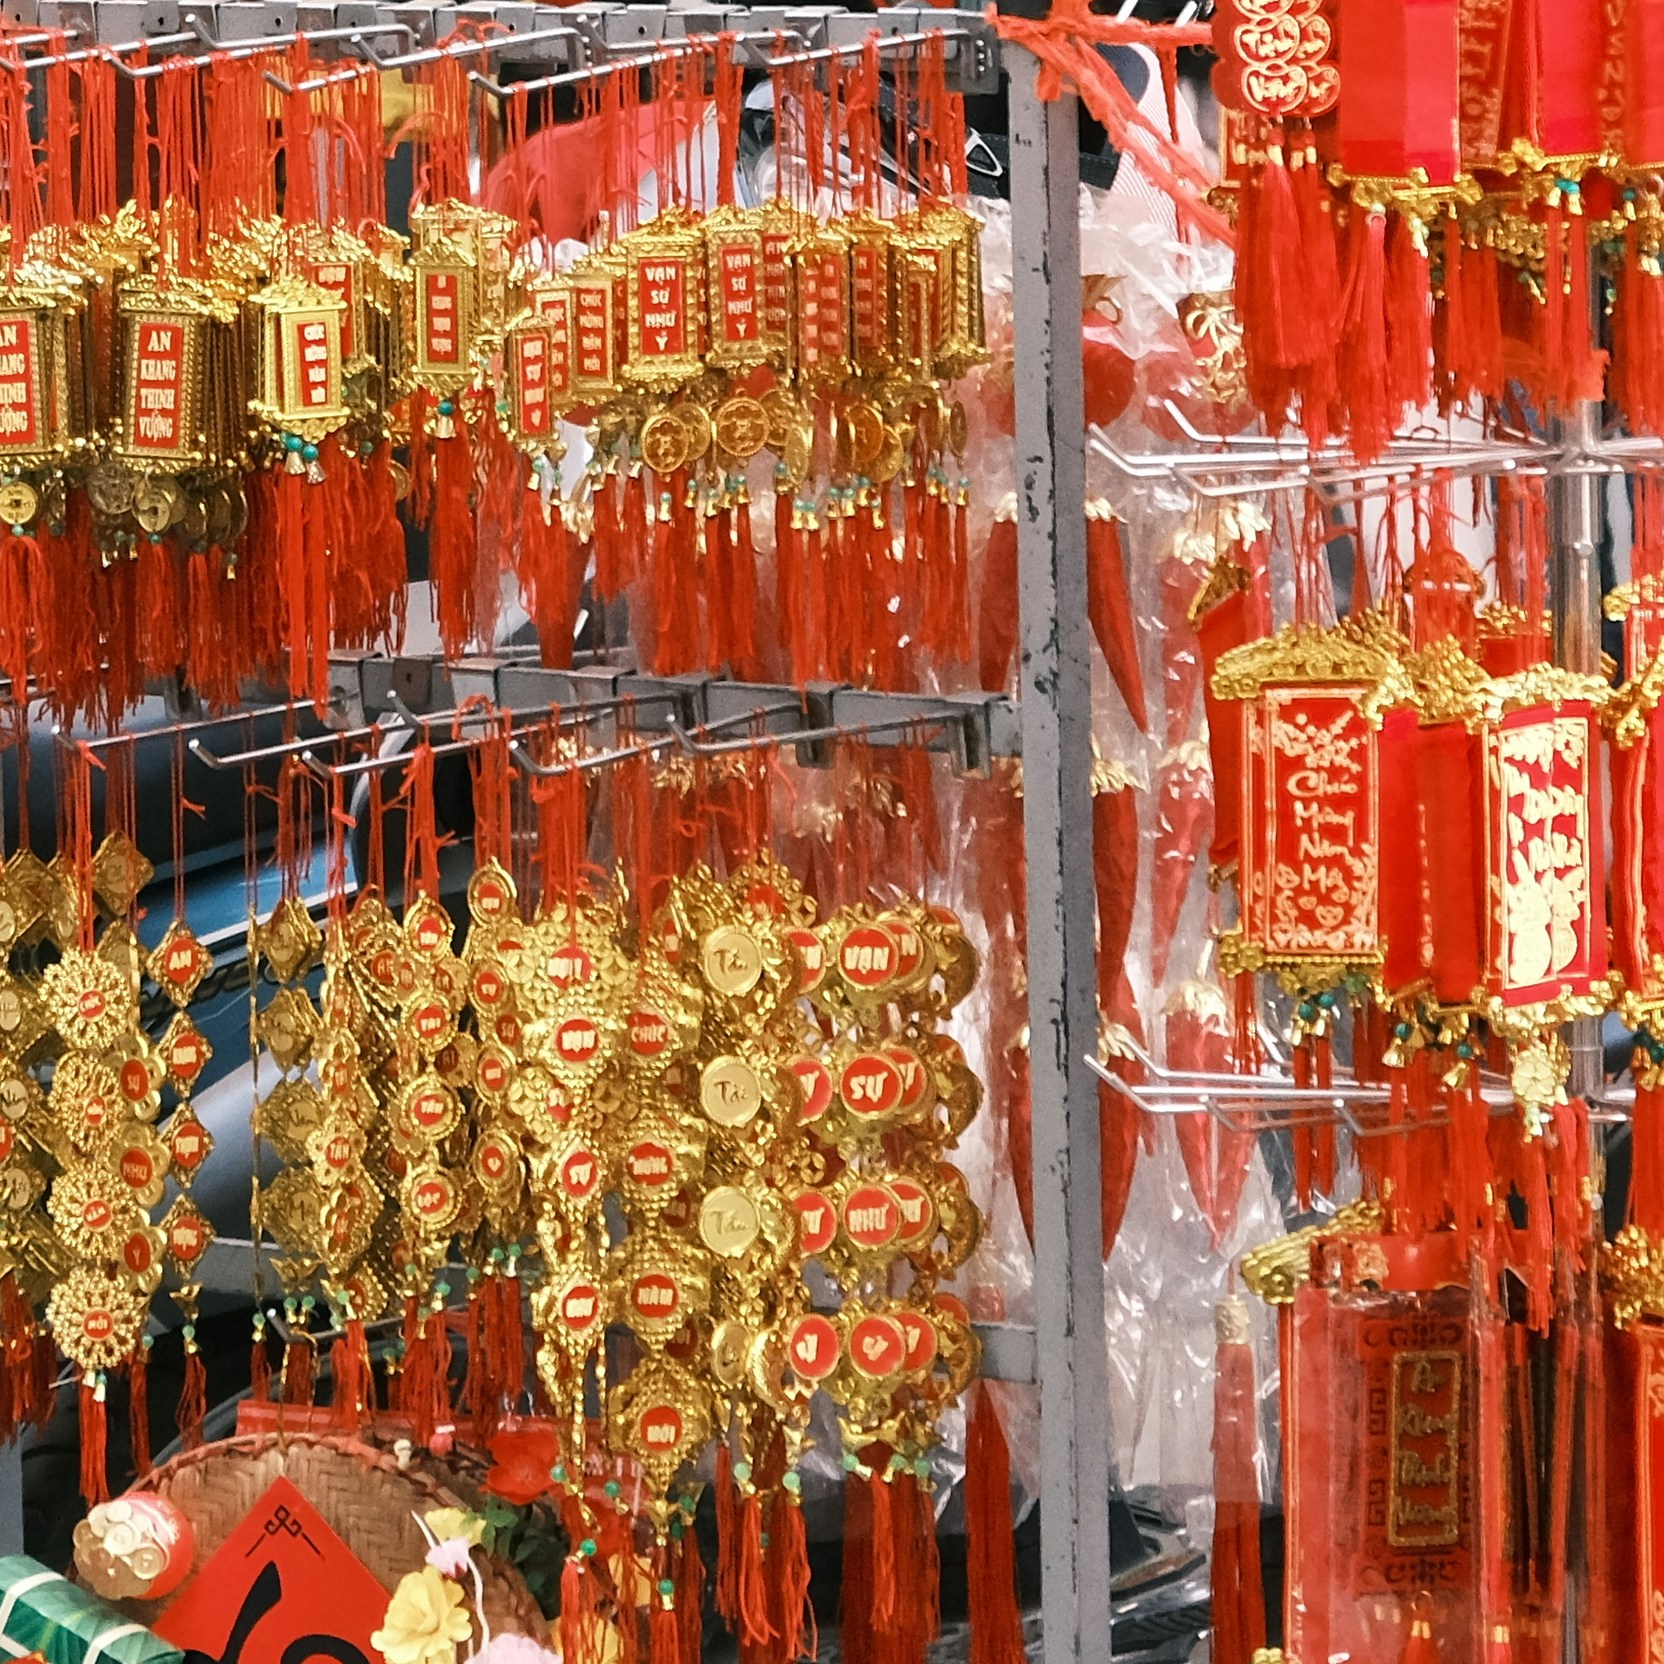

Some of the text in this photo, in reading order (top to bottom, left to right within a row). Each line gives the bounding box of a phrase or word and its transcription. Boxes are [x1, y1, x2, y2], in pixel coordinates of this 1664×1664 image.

[645, 266, 677, 287] VẠN
[650, 287, 671, 310] SỰ
[644, 309, 677, 329] NHƯ
[736, 317, 748, 339] Ý
[147, 331, 172, 352] AN
[654, 330, 669, 352] Ý
[140, 359, 177, 381] KHANG
[844, 944, 890, 975] VẠN
[849, 1070, 889, 1104] SỰ
[848, 1202, 890, 1233] NHƯ
